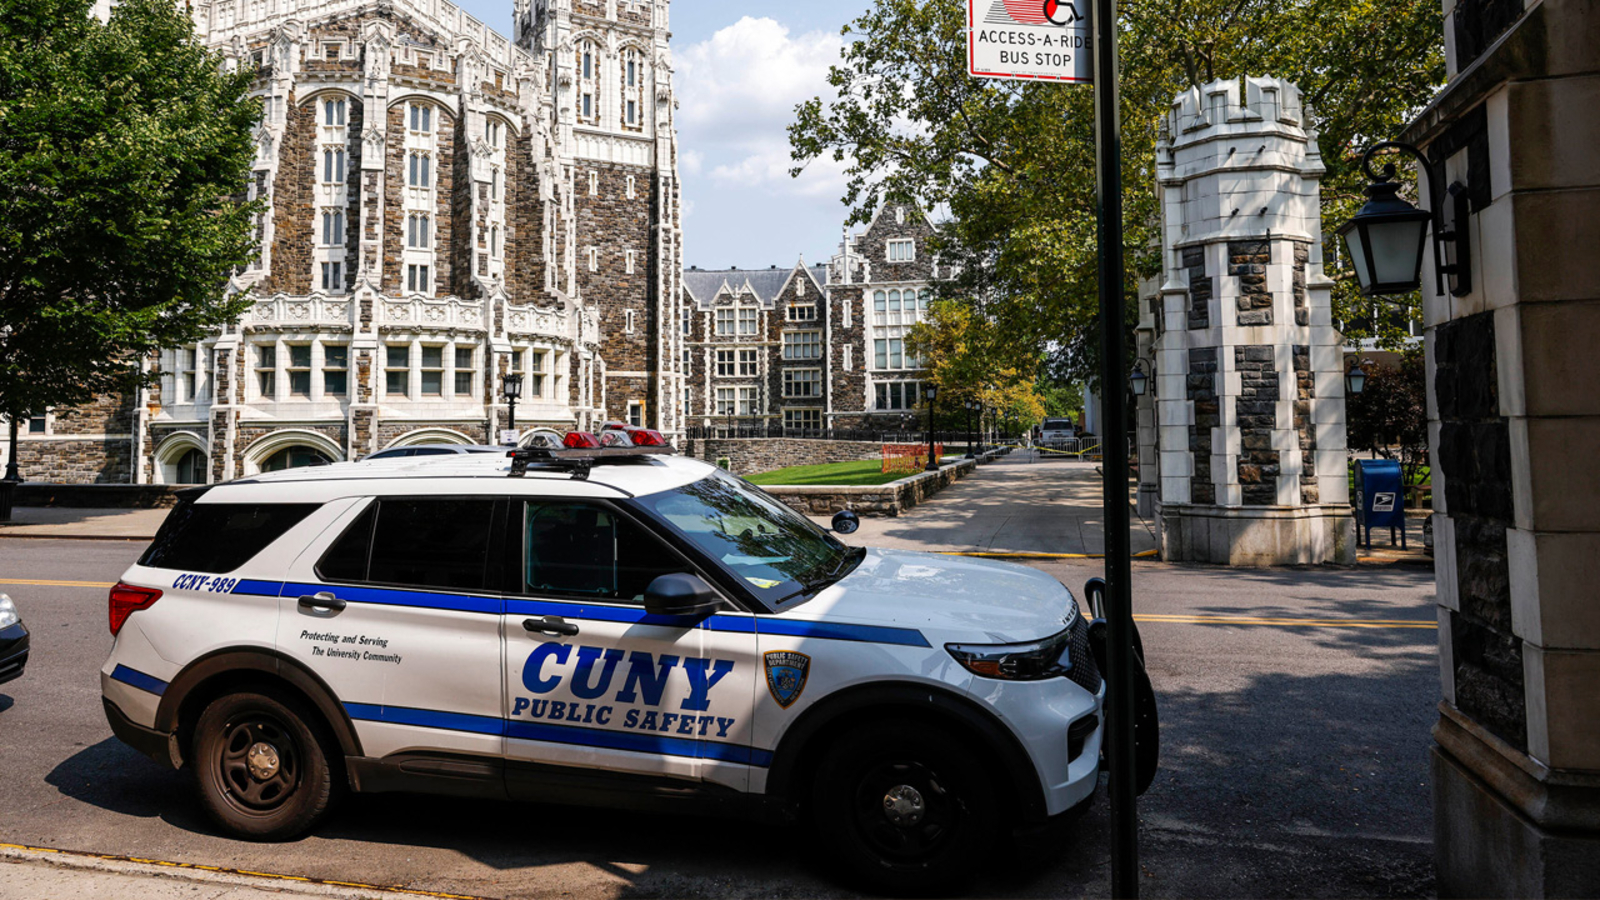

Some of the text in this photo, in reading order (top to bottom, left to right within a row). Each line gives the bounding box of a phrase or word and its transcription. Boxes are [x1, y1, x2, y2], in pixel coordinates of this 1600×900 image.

[978, 29, 1093, 49] ACCESS-A-RIDE
[1000, 50, 1071, 67] BUS STOP
[172, 573, 237, 593] CCNY-989
[300, 630, 389, 648] Protecting and Serving
[311, 646, 402, 664] The University Community
[522, 641, 735, 711] CUNY
[511, 697, 735, 738] PUBLIC SAFETY
